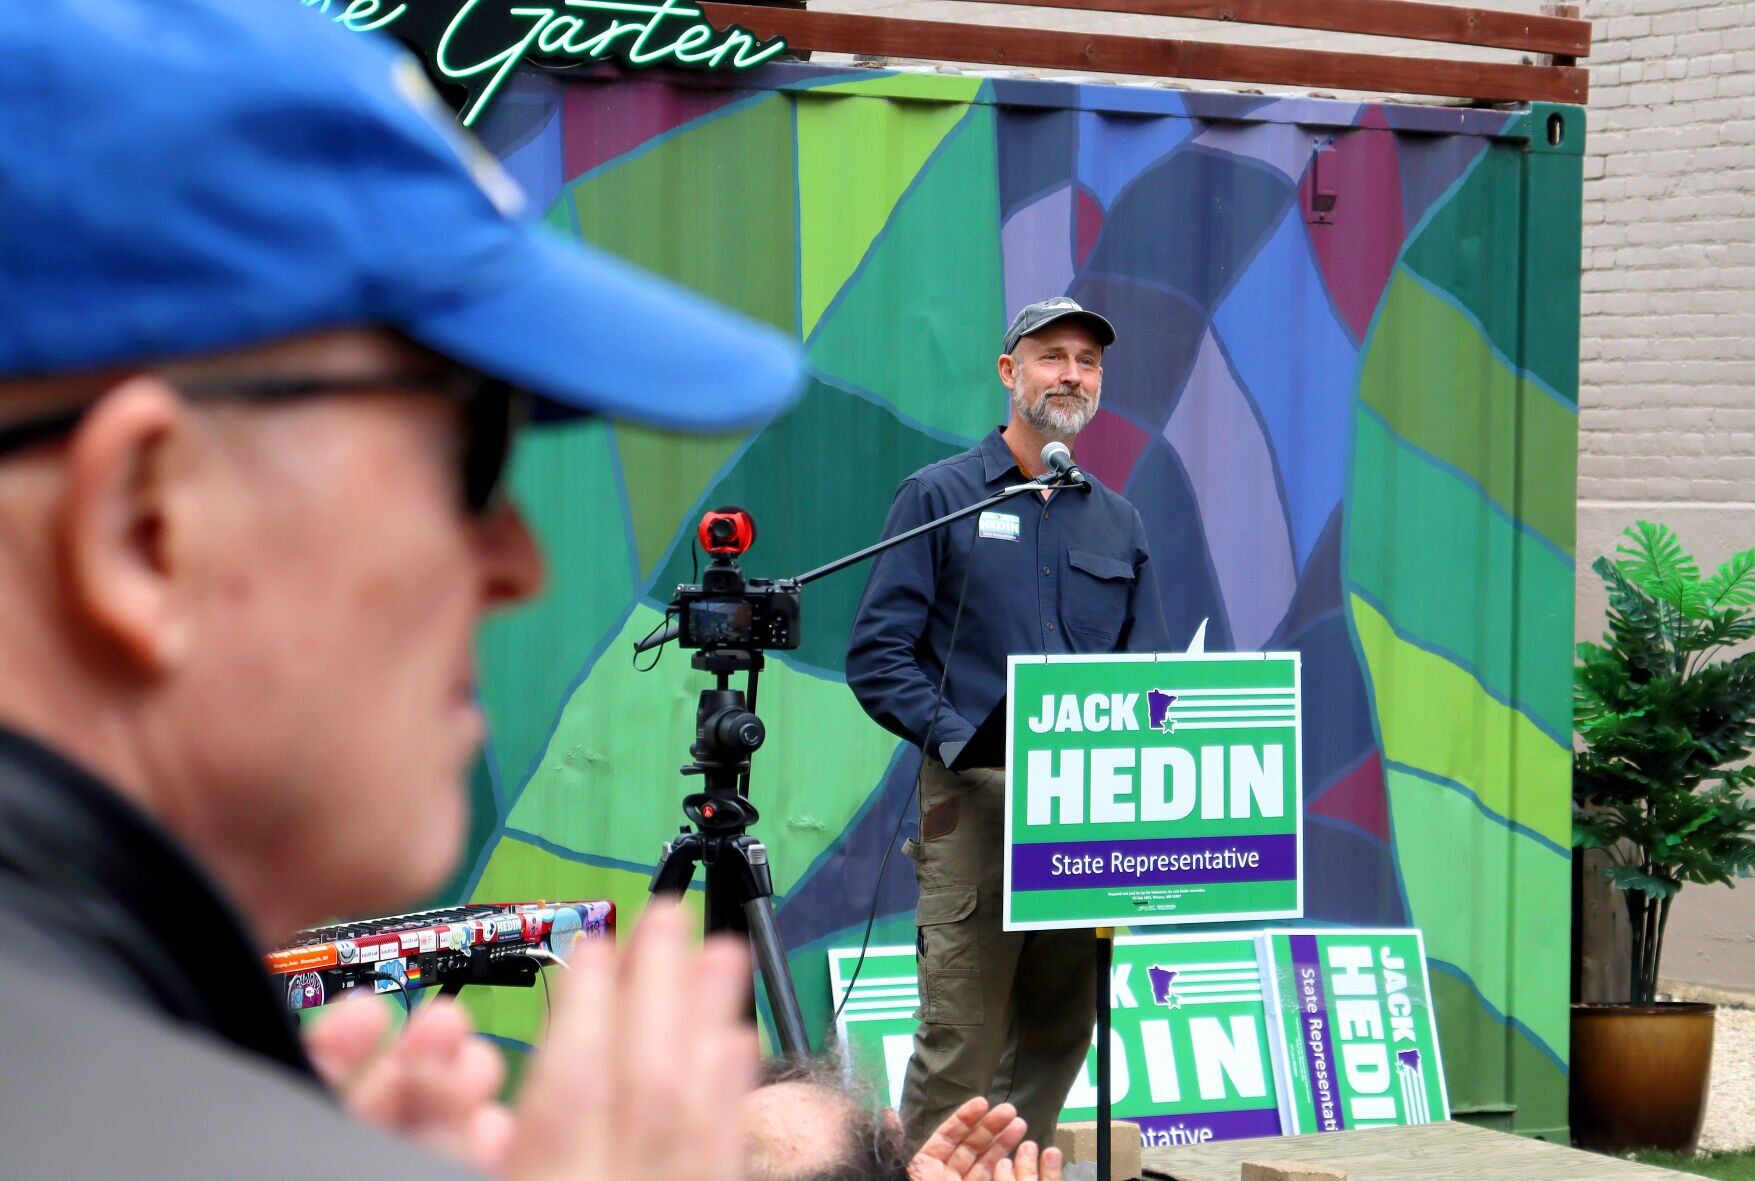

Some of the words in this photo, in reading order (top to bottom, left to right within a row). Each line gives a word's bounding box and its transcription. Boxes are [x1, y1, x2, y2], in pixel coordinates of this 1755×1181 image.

[437, 0, 786, 127] Garten
[1028, 693, 1140, 734] JACK
[1027, 744, 1284, 826] HEDIN
[1051, 854, 1104, 876] State
[1111, 848, 1260, 877] Representative
[1302, 968, 1318, 1014] State
[1380, 946, 1416, 1043] JACK
[1309, 1018, 1339, 1131] Representati
[1327, 946, 1398, 1131] HEDI
